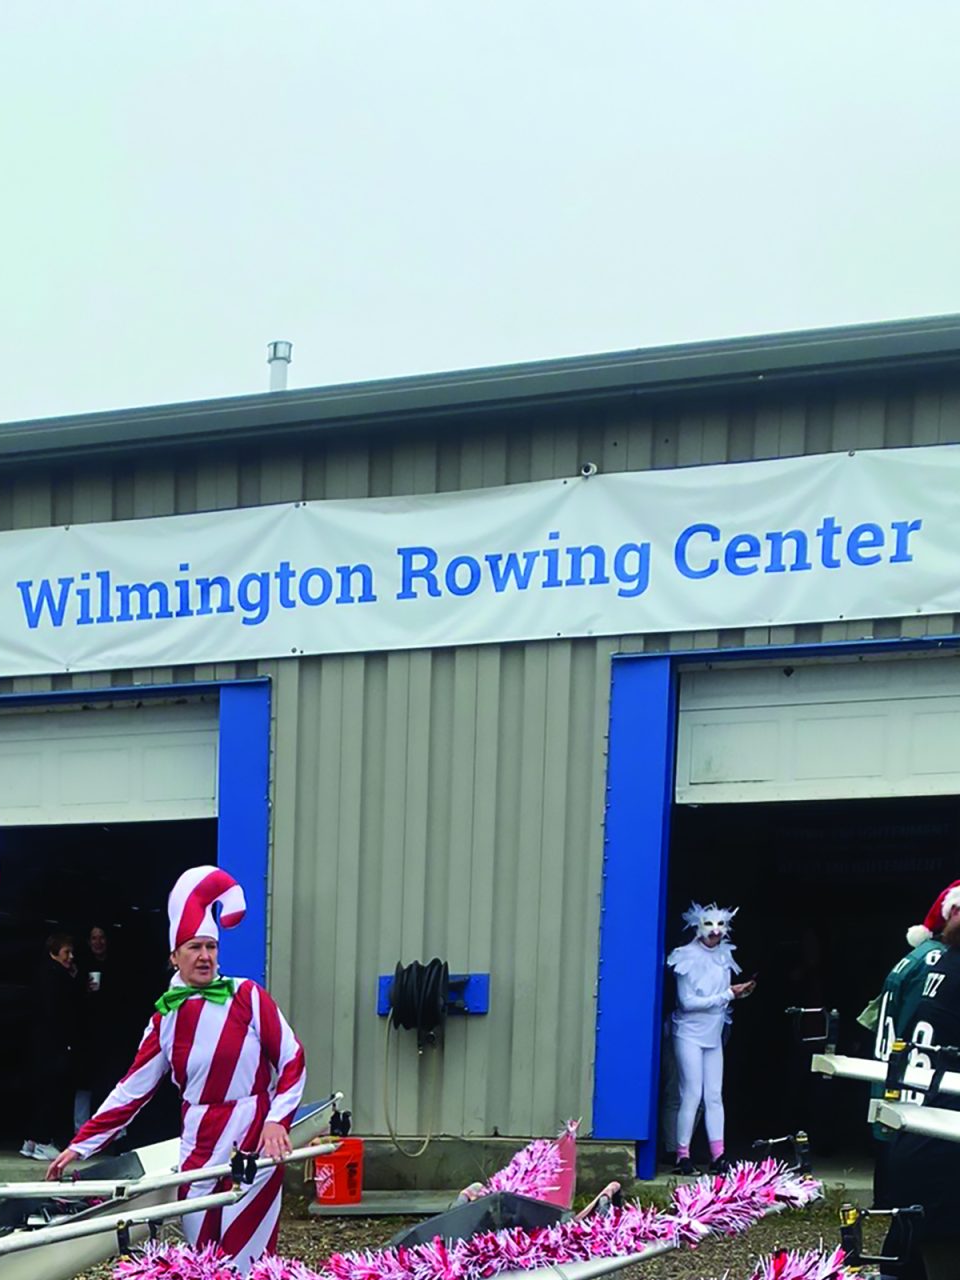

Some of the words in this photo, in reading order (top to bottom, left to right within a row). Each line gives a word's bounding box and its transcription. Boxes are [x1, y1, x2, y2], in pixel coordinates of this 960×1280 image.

[17, 561, 378, 629] Wilmington
[396, 531, 651, 600] Rowing
[674, 516, 923, 580] Center
